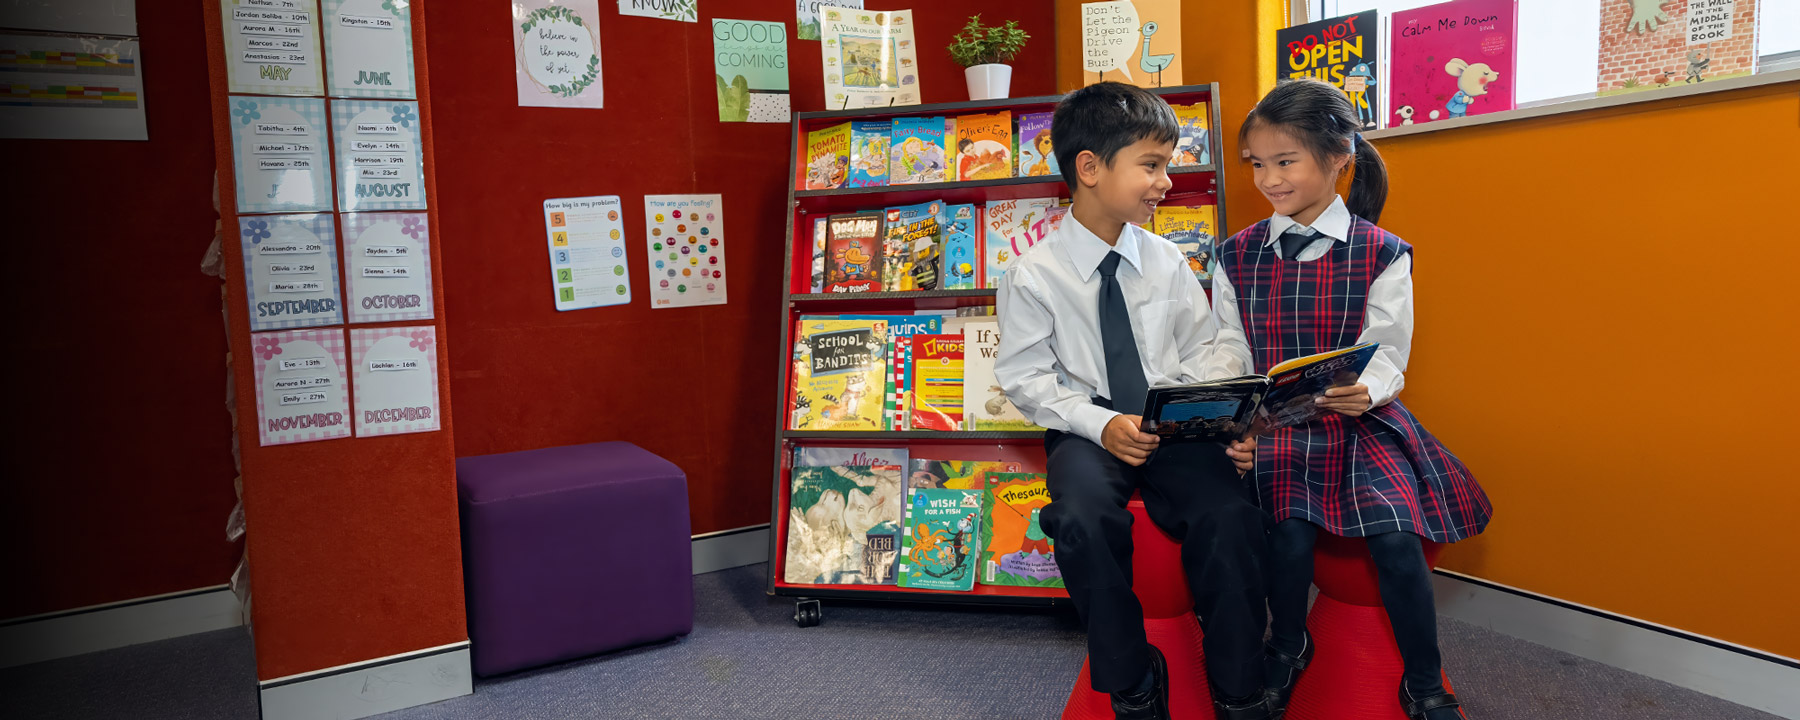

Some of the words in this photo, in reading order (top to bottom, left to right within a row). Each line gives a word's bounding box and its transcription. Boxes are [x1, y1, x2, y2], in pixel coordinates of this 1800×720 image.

[1086, 5, 1121, 15] Don't
[1690, 1, 1705, 9] THE
[1086, 17, 1107, 26] Let
[1112, 15, 1132, 24] the
[1438, 17, 1457, 31] Me
[1463, 15, 1498, 26] Down
[1690, 13, 1730, 26] MIDDLE
[713, 20, 785, 44] GOOD
[831, 23, 839, 32] A
[840, 24, 859, 33] YEAR
[1086, 26, 1130, 37] Pigeon
[1691, 25, 1704, 33] OF
[1086, 37, 1123, 47] Drive
[1287, 34, 1318, 58] DO
[1322, 15, 1359, 46] NOT
[1691, 30, 1725, 42] BOOK
[1087, 47, 1109, 57] the
[1289, 35, 1363, 71] OPEN
[718, 51, 785, 69] COMING
[1087, 58, 1114, 68] Bus!
[260, 65, 292, 81] MAY
[354, 70, 392, 86] JUNE
[893, 127, 915, 138] Fairy
[917, 125, 942, 138] Bread
[810, 133, 846, 153] TOMATO
[811, 142, 848, 162] DYNAMITE
[355, 182, 411, 198] AUGUST
[562, 202, 572, 210] big
[591, 198, 619, 208] problem?
[677, 201, 689, 209] you
[989, 199, 1018, 218] GREAT
[554, 214, 562, 225] 5
[990, 212, 1013, 231] DAY
[888, 225, 908, 237] FIRE
[908, 221, 919, 232] IN
[919, 216, 936, 229] THE
[902, 223, 938, 243] FOREST!
[1001, 227, 1014, 239] for
[556, 233, 564, 244] 4
[559, 251, 566, 262] 3
[561, 270, 569, 281] 2
[257, 298, 336, 317] SEPTEMBER
[362, 294, 421, 310] OCTOBER
[818, 333, 864, 349] SCHOOL
[976, 329, 991, 343] If
[833, 346, 845, 357] for
[936, 343, 965, 353] KIDS
[980, 347, 998, 358] We
[814, 353, 868, 370] BANDITS
[365, 405, 432, 424] DECEMBER
[268, 411, 343, 432] NOVEMBER
[930, 499, 957, 508] WISH
[869, 537, 892, 550] BED
